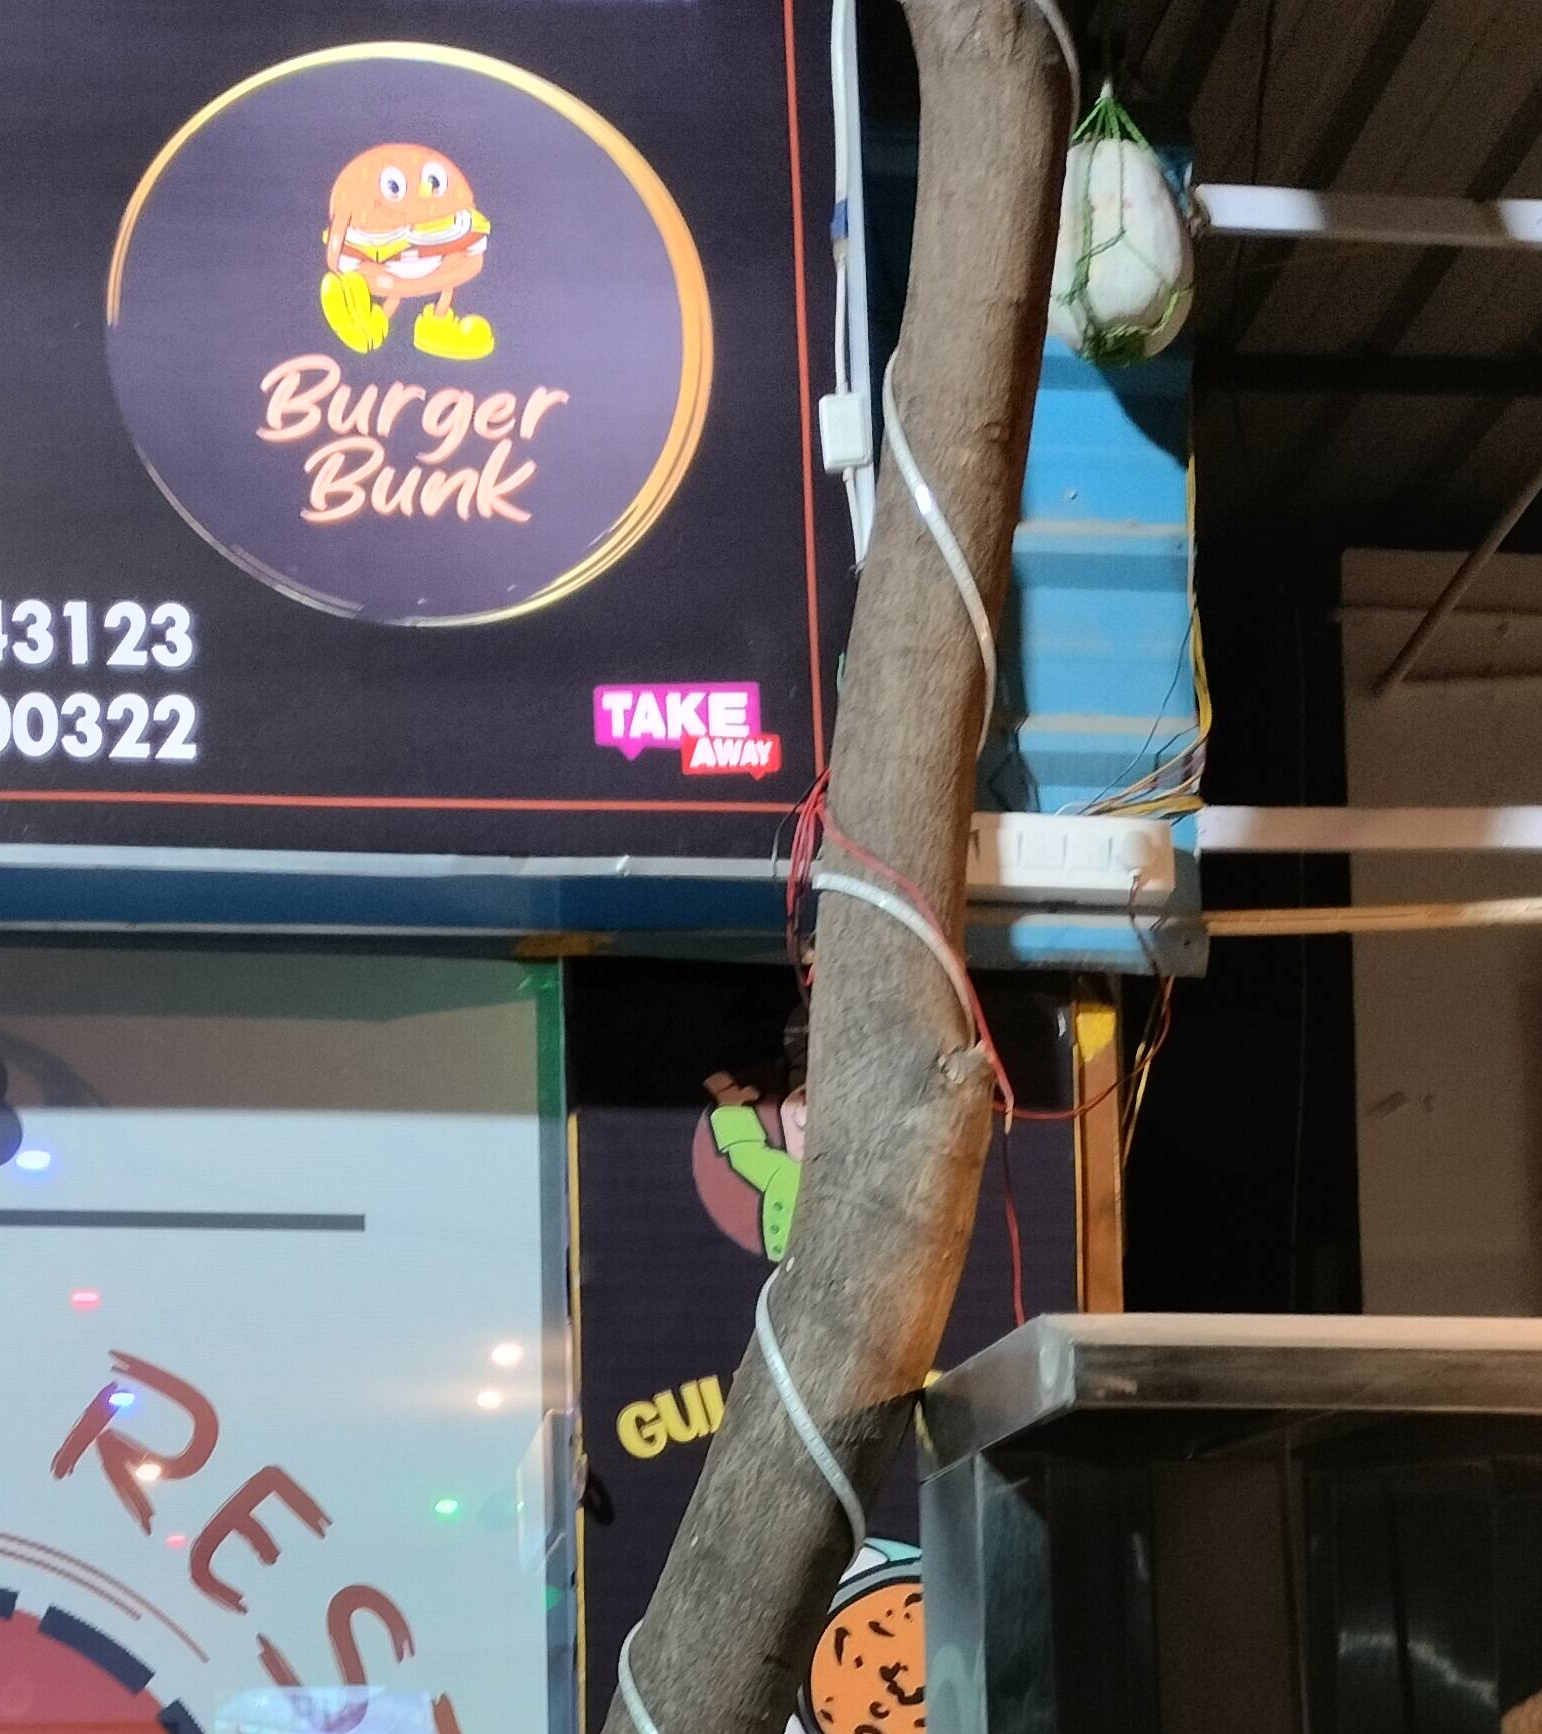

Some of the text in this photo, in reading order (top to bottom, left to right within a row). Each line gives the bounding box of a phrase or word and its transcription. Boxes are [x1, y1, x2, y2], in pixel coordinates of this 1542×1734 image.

[256, 353, 569, 464] Burger
[300, 436, 537, 524] Bunk
[602, 690, 750, 740] TAKE
[689, 736, 774, 769] AWAY
